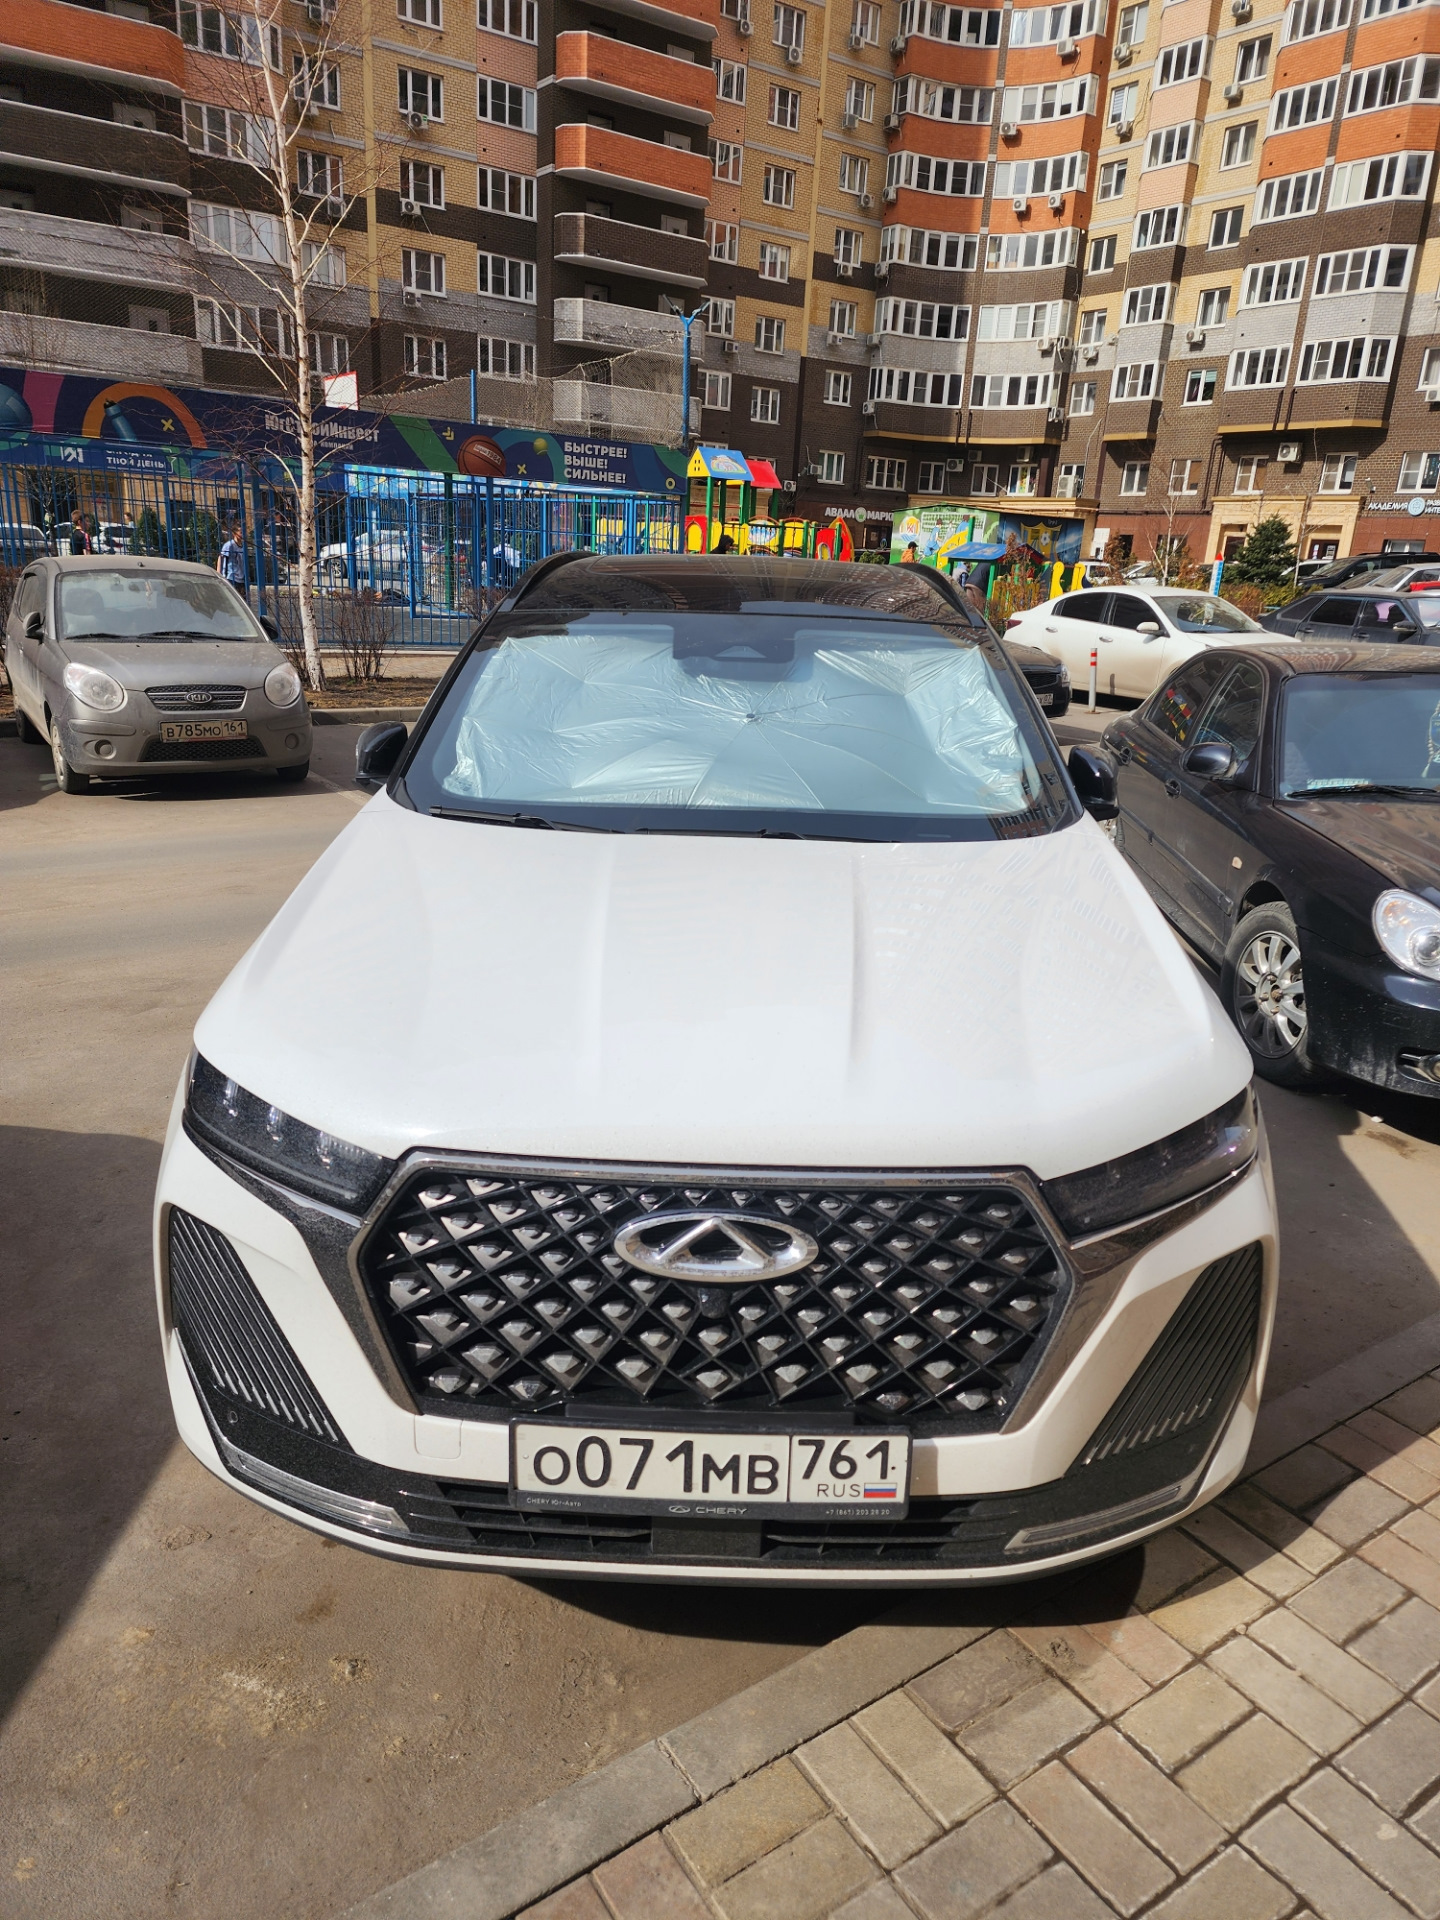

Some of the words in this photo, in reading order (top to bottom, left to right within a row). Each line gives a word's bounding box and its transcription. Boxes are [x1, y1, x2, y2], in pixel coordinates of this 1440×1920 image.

[265, 414, 380, 442] ЮгСтойИнвест
[564, 441, 628, 459] БЫСТРЕЕ!
[564, 454, 608, 469] ВЫШЕ!
[563, 467, 627, 484] СИЛЬНЕЕ!
[1367, 502, 1409, 511] АКАДЕМИЯ
[166, 724, 221, 738] В785МО
[223, 721, 244, 732] 161
[533, 1435, 780, 1496] О071МВ
[797, 1439, 891, 1480] 761
[816, 1483, 861, 1498] RUS
[695, 1506, 747, 1515] CHERY
